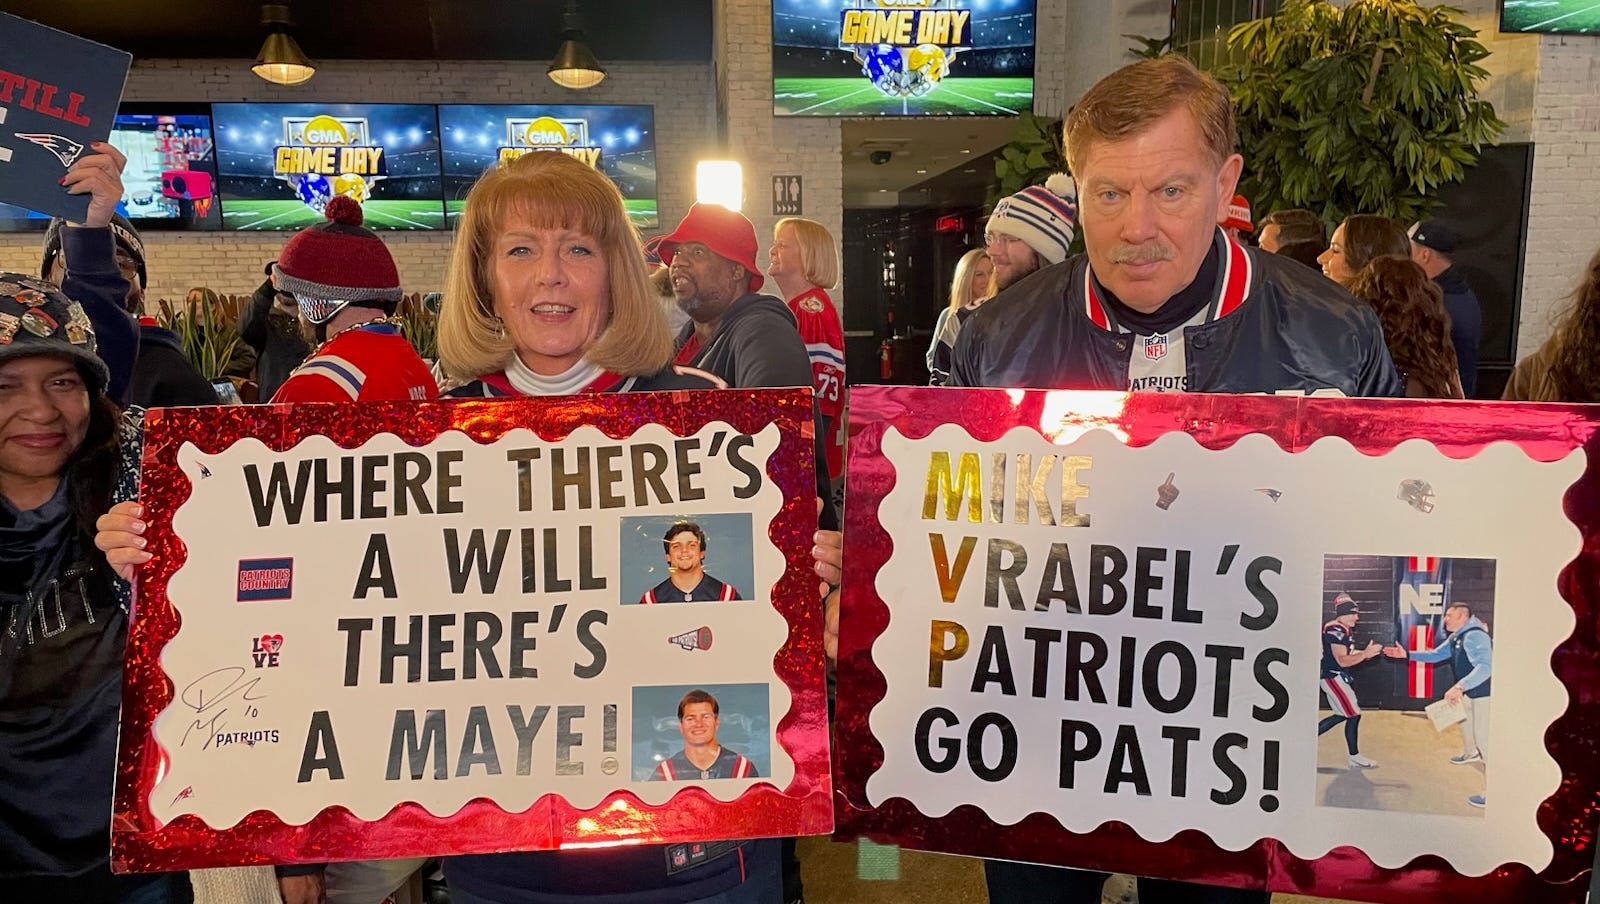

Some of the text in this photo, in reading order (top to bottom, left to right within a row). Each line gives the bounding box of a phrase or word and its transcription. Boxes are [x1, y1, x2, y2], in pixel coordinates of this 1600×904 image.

[842, 10, 970, 44] GAME DAY
[307, 129, 345, 144] GMA
[529, 130, 566, 145] GMA
[275, 147, 383, 174] GAME DAY
[1147, 344, 1166, 357] NFL
[817, 374, 839, 401] 73
[1128, 376, 1188, 391] ATRIOTS
[242, 431, 762, 527] WHERE THERE'S
[922, 451, 1094, 528] MIKE
[240, 569, 290, 581] PATRIOTS
[352, 525, 607, 599] A WILL
[240, 579, 289, 591] COUNTRY
[928, 533, 1282, 631] VRABEL'S
[1400, 583, 1444, 615] NE
[337, 604, 608, 687] THERE'S
[928, 619, 1290, 722] PATRIOTS
[216, 729, 279, 748] PATRIOTS
[297, 711, 345, 783] A
[385, 704, 618, 780] MAYE!
[914, 706, 1280, 812] GO PATS!
